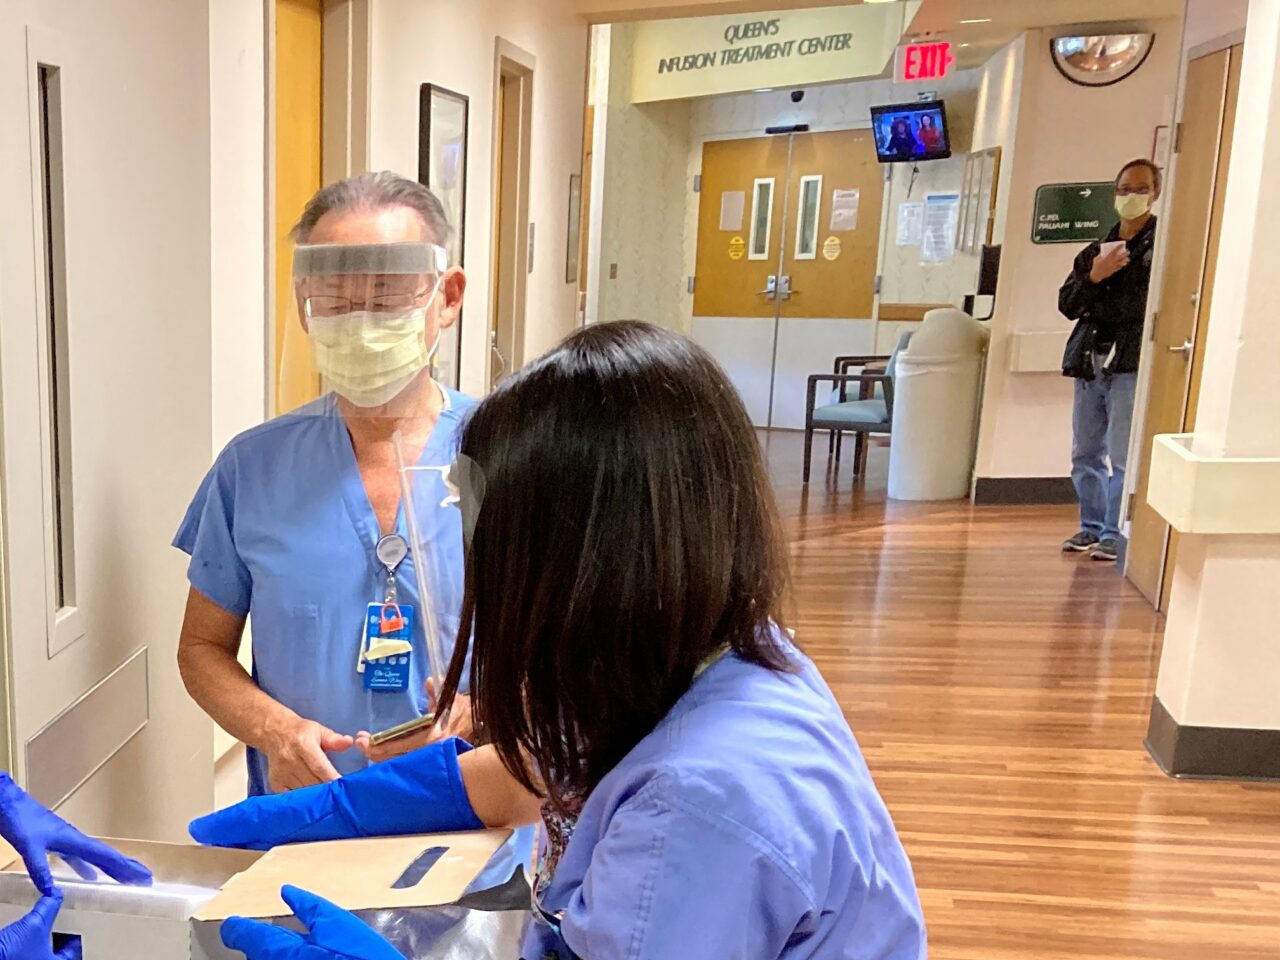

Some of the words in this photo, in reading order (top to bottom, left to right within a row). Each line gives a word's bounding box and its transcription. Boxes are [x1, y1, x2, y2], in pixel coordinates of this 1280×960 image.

[724, 18, 780, 42] QUEEN'S
[657, 49, 716, 74] INFUSION
[720, 40, 795, 65] TREATMENT
[798, 32, 853, 55] CENTER
[904, 42, 950, 80] EXIT
[1074, 220, 1099, 228] WING
